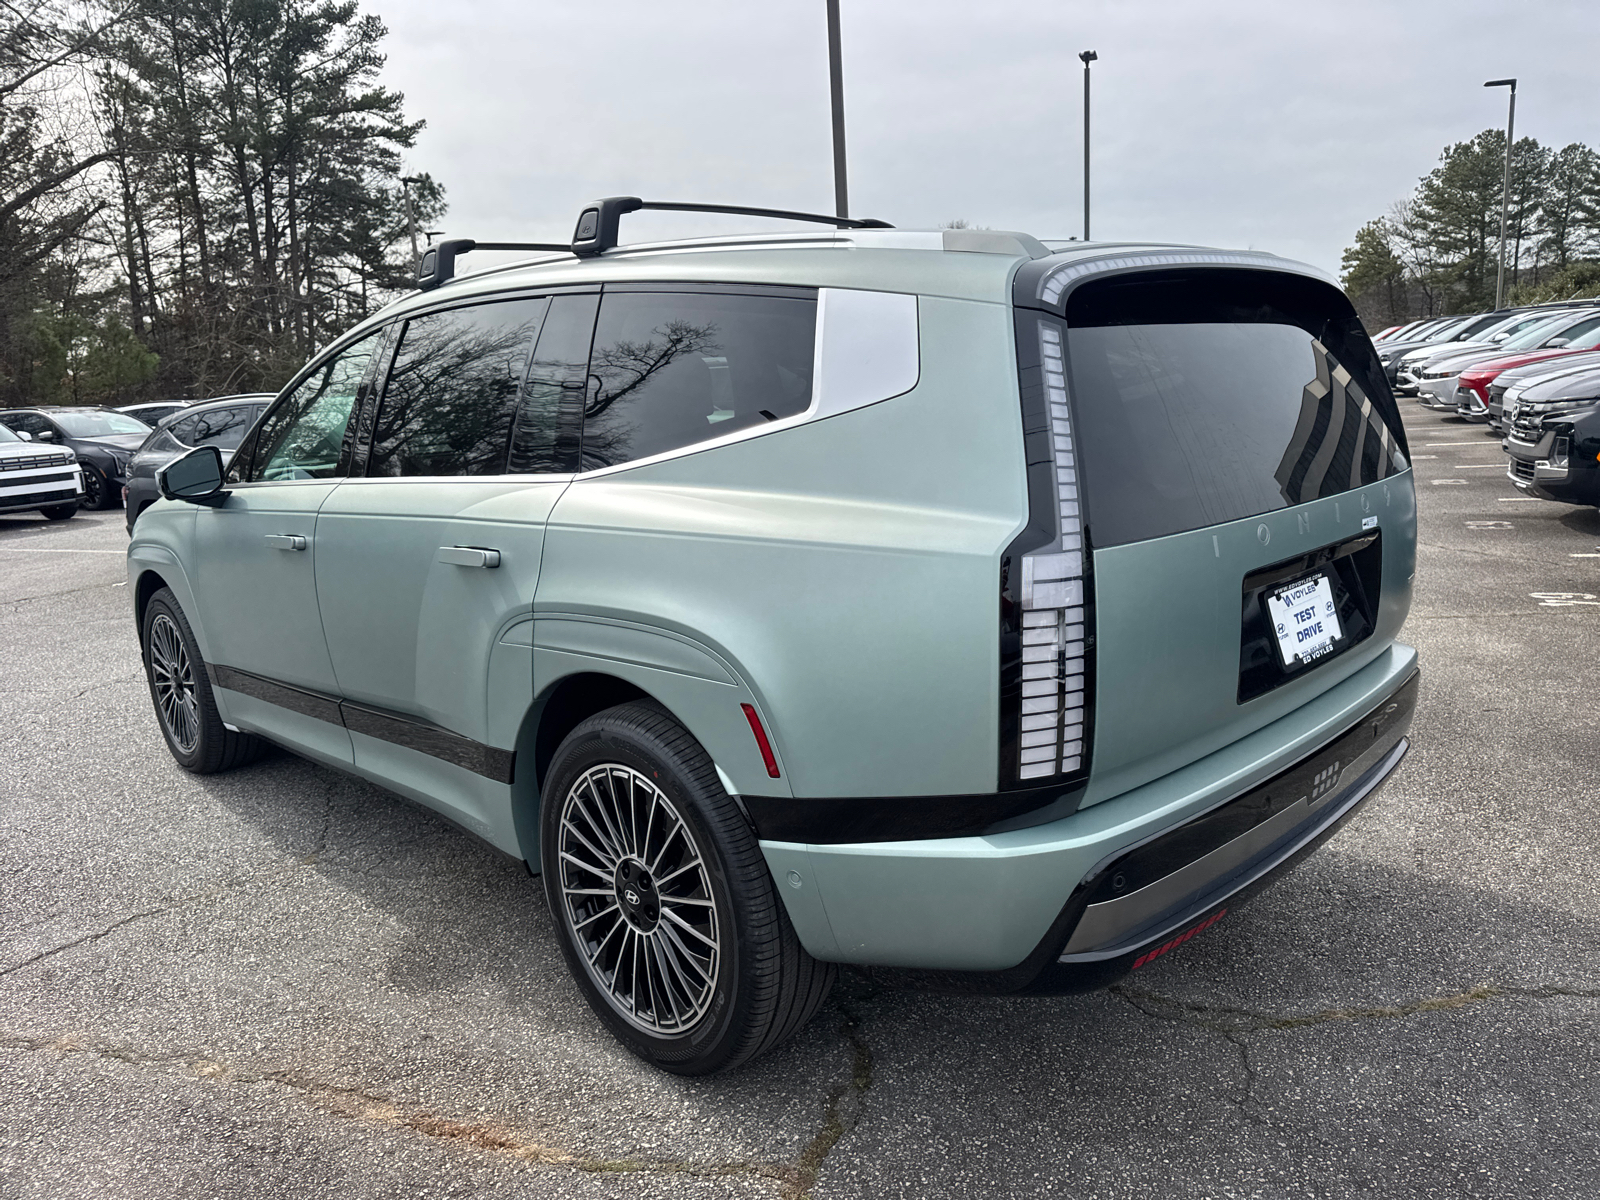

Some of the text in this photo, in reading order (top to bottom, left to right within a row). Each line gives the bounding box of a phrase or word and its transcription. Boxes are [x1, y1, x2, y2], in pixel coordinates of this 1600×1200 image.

[1274, 572, 1322, 595] WWW.EDVOYLES.COM
[1290, 584, 1316, 601] VOYLES
[1293, 605, 1316, 625] TEST
[1296, 621, 1324, 643] DRIVE
[1302, 655, 1312, 665] ED
[1311, 644, 1334, 660] VOYLES
